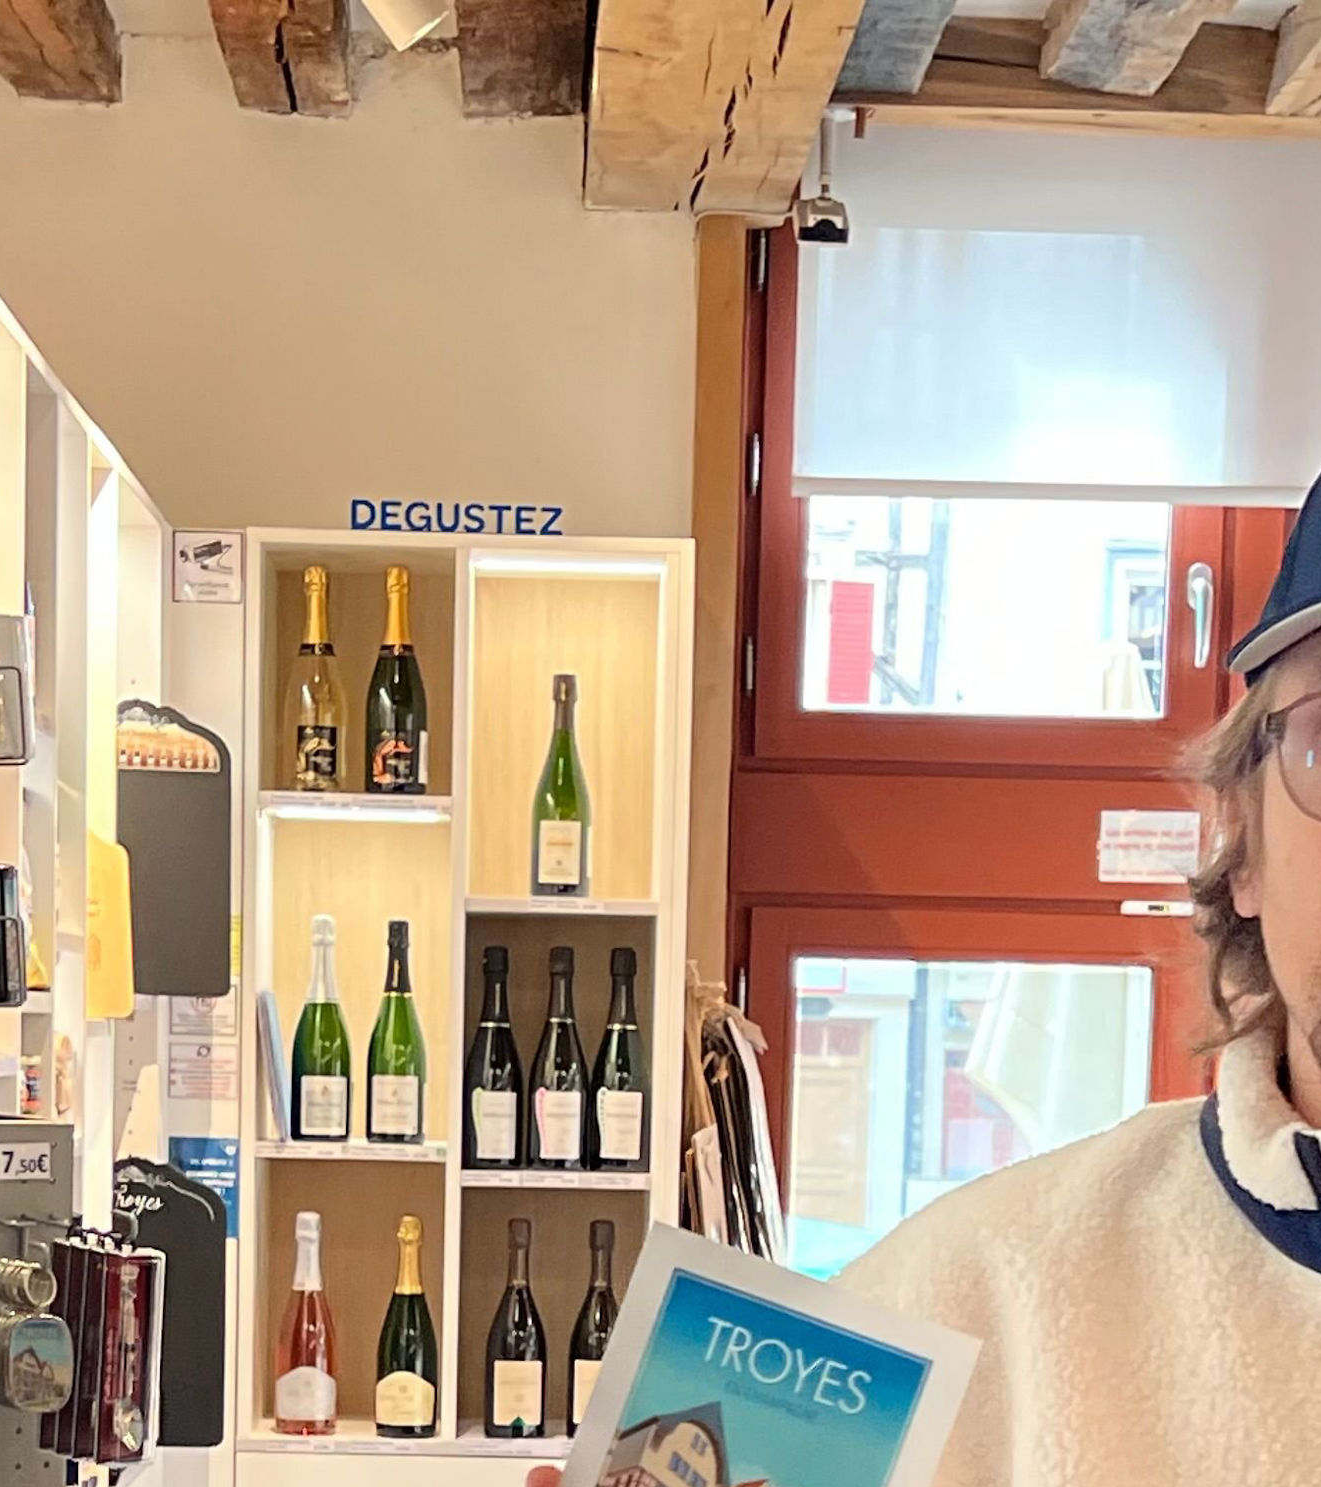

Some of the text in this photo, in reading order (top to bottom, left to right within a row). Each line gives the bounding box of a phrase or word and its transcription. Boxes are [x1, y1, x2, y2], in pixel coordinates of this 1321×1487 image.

[350, 499, 564, 536] DEGUSTEZ
[1, 1150, 49, 1177] 7,50€
[706, 1317, 873, 1416] TROYES
